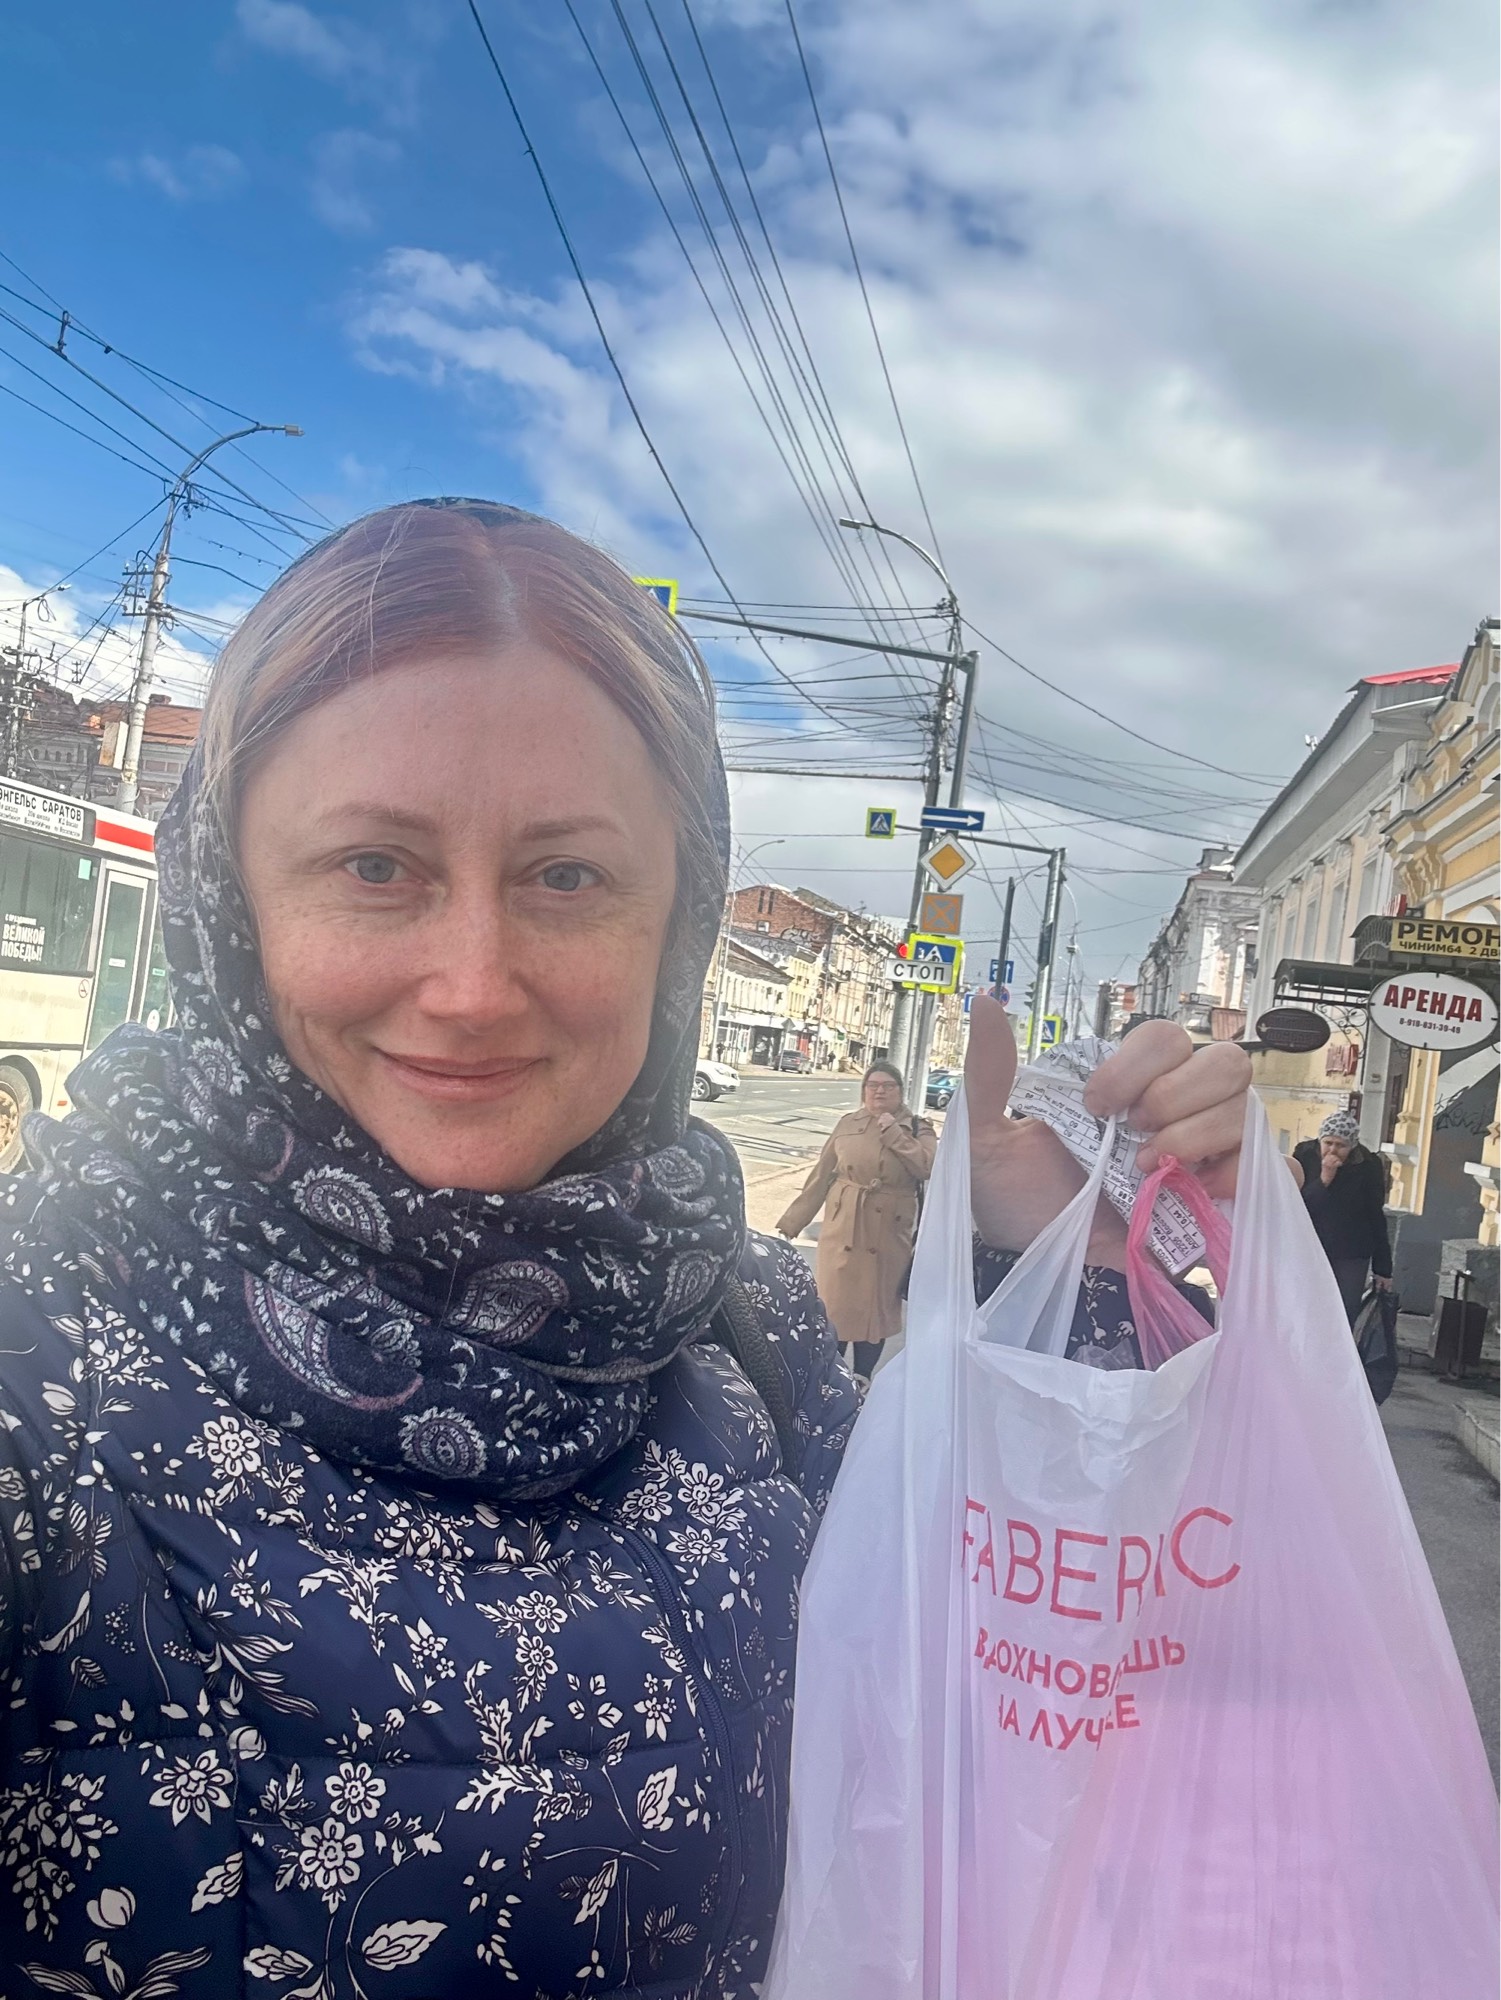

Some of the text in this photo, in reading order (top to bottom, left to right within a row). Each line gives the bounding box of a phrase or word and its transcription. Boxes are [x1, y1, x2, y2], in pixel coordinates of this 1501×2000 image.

[42, 799, 82, 822] САРАТОВ
[3, 923, 46, 946] ВЕЛИКОЙ
[1, 940, 44, 962] ПОБЕДЫ!
[1399, 941, 1500, 958] ЧИНИМ64 2 ДВ
[893, 963, 945, 982] СТОП
[1383, 983, 1483, 1023] АРЕНДА
